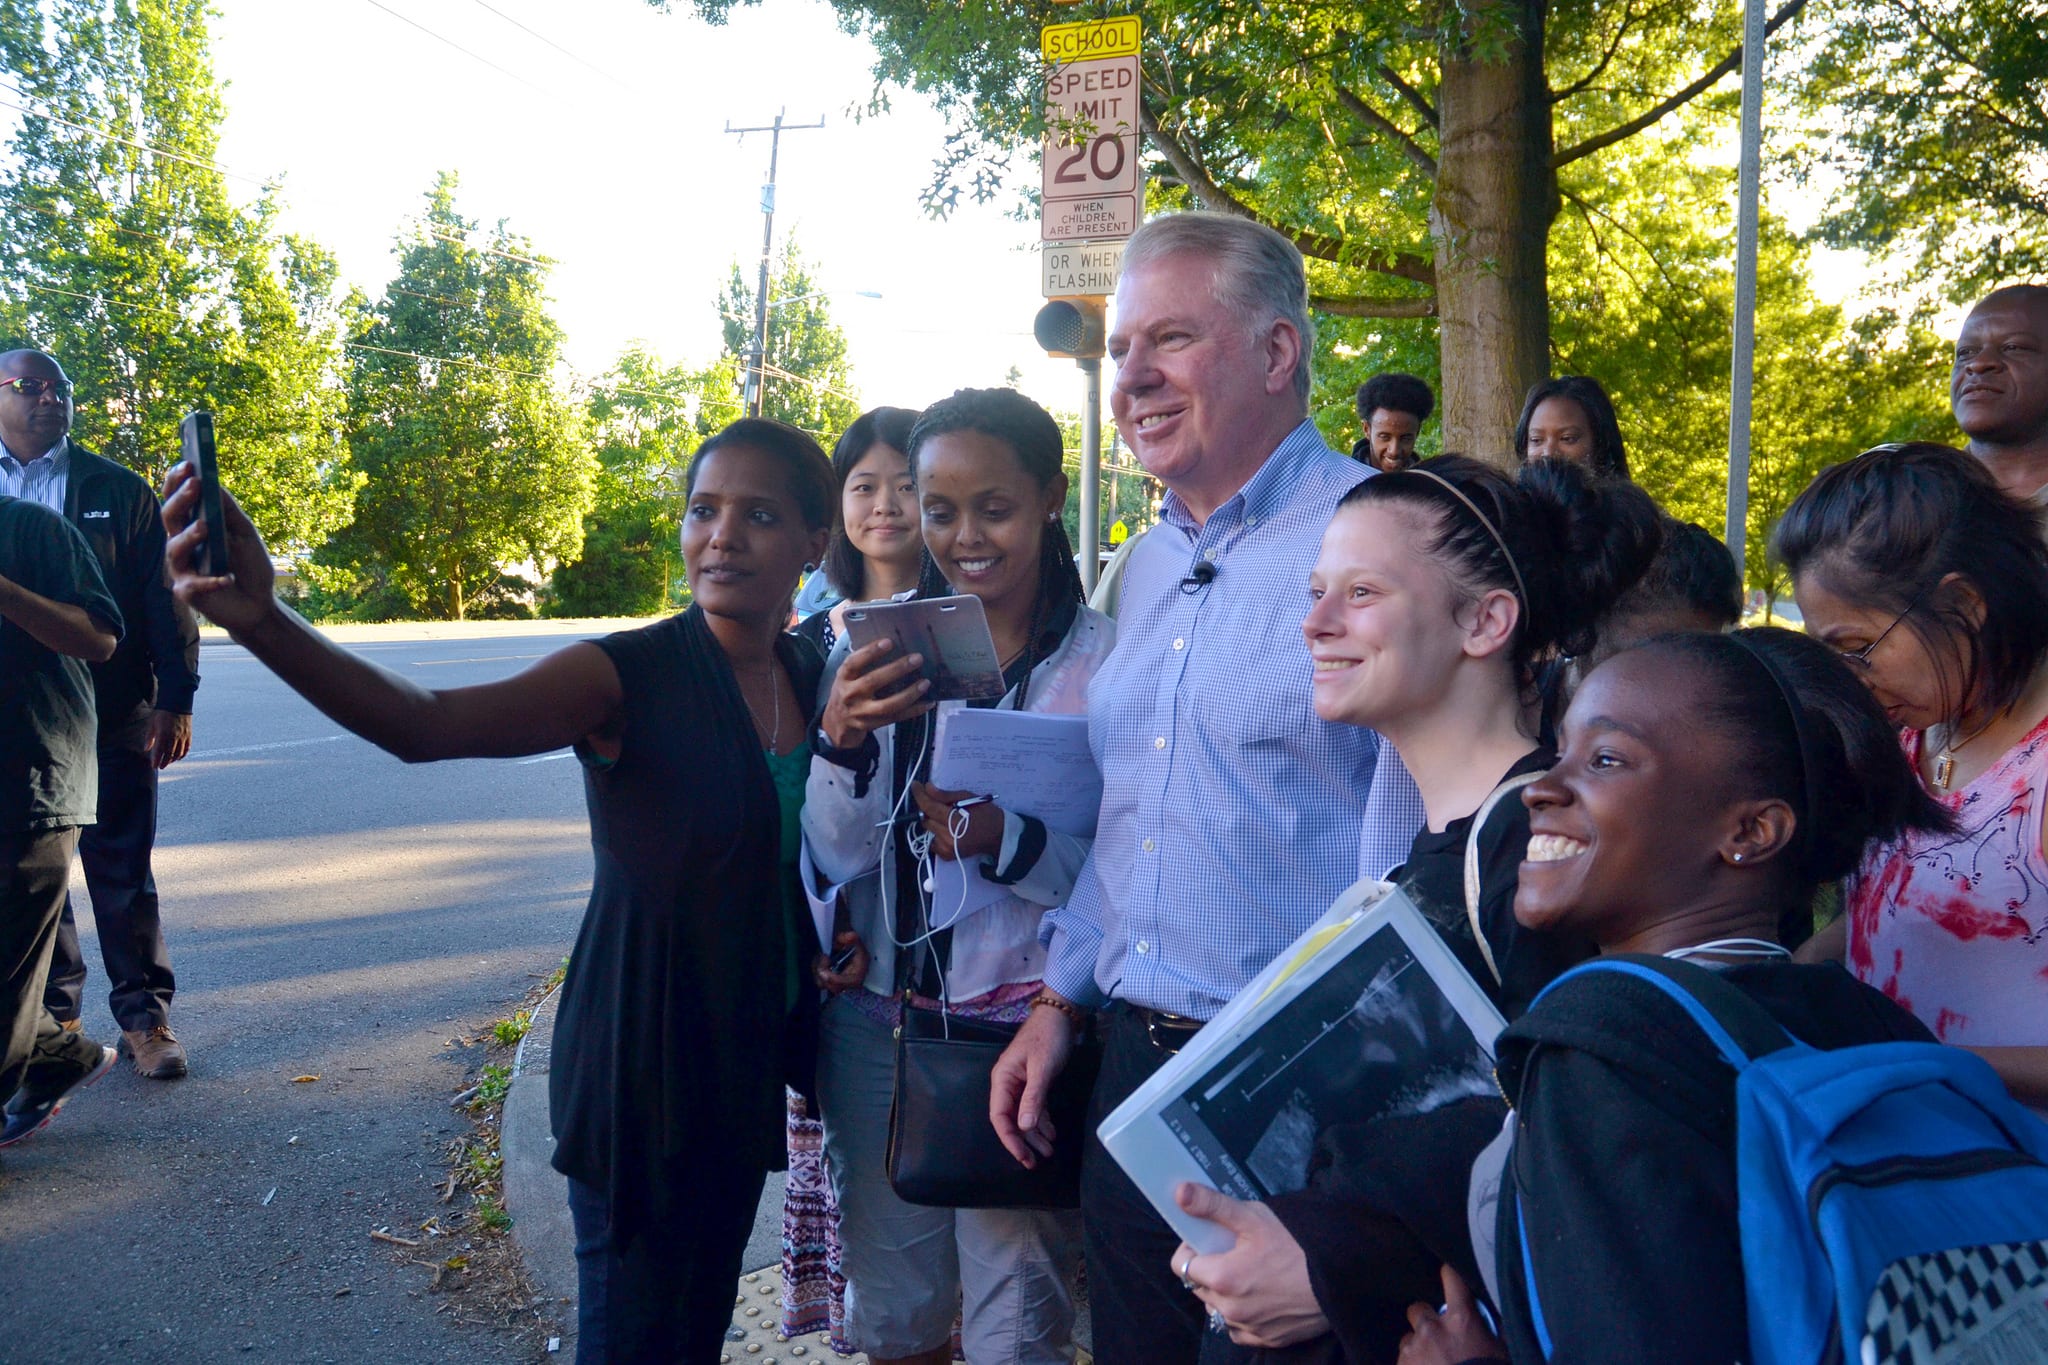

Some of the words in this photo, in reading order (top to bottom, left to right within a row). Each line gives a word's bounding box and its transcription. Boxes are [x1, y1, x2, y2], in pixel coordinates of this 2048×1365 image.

[1050, 27, 1131, 54] SCHOOL
[1050, 68, 1132, 96] SPEED
[1054, 132, 1125, 184] 20
[1073, 202, 1104, 213] WHEN
[1061, 212, 1115, 224] CHILDREN
[1049, 225, 1071, 236] ARE
[1077, 222, 1128, 233] PRESENT
[1050, 254, 1070, 269] OR
